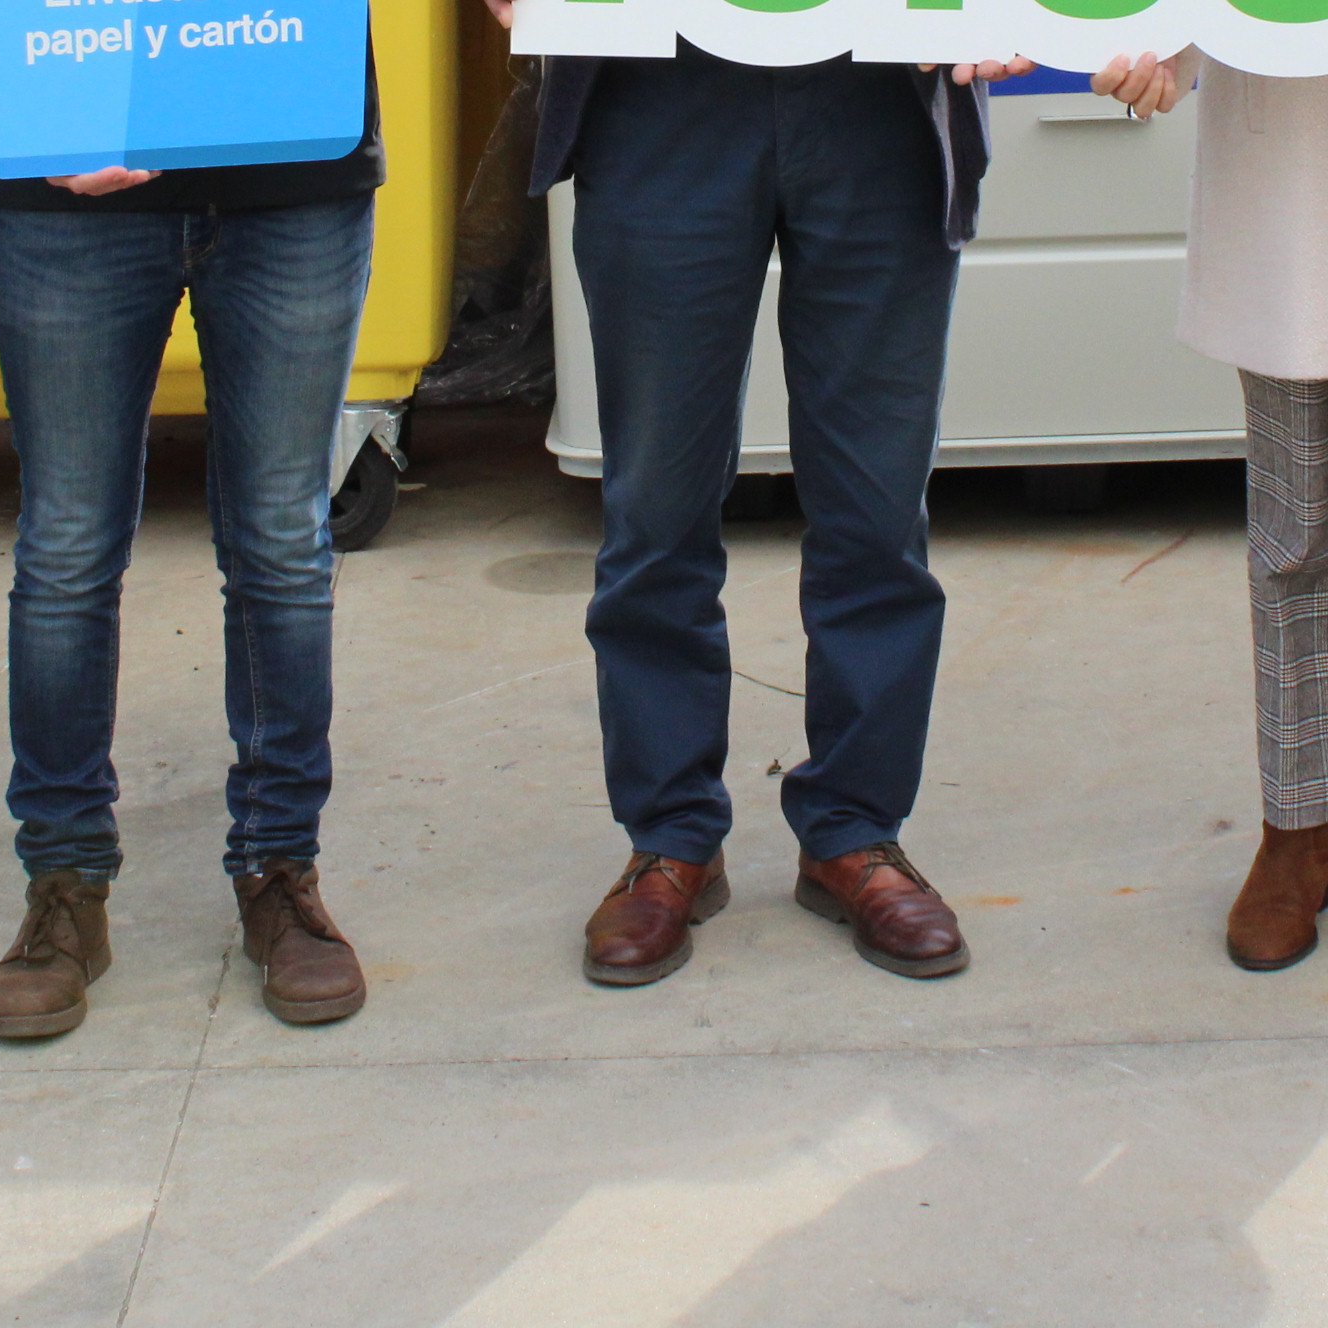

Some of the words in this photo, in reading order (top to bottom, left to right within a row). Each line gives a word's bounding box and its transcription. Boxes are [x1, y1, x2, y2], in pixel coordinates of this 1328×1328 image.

[26, 18, 133, 65] papel
[144, 24, 168, 59] y
[179, 9, 304, 48] cartón
